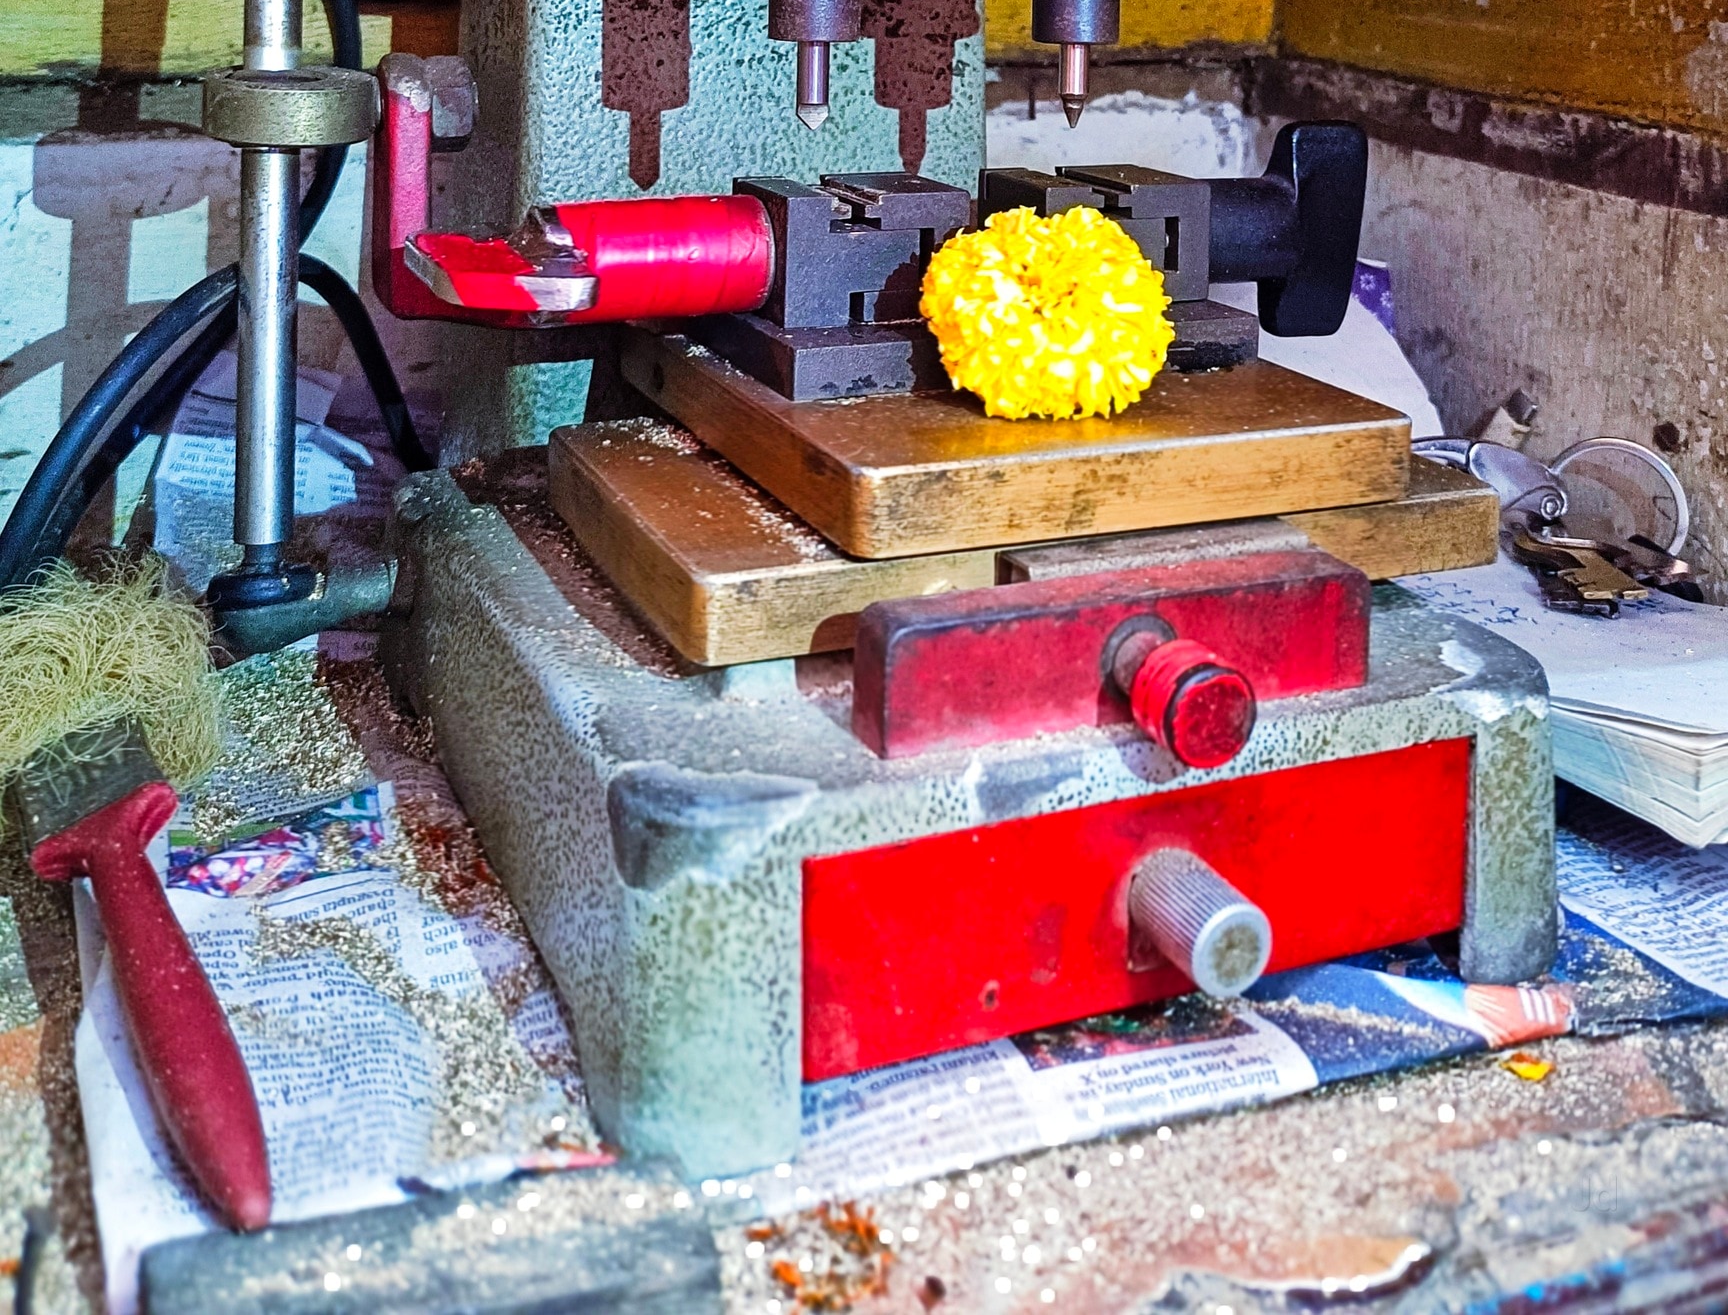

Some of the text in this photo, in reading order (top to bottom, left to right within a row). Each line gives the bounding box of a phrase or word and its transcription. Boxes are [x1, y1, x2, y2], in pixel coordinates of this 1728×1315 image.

[423, 922, 467, 942] catch
[425, 933, 497, 957] who also
[1121, 1056, 1178, 1073] shared
[1193, 1060, 1234, 1077] York
[1235, 1054, 1272, 1070] New
[1097, 1068, 1118, 1080] on
[1168, 1067, 1190, 1081] on
[1098, 1072, 1168, 1096] Sunday,
[1169, 1070, 1281, 1101] International
